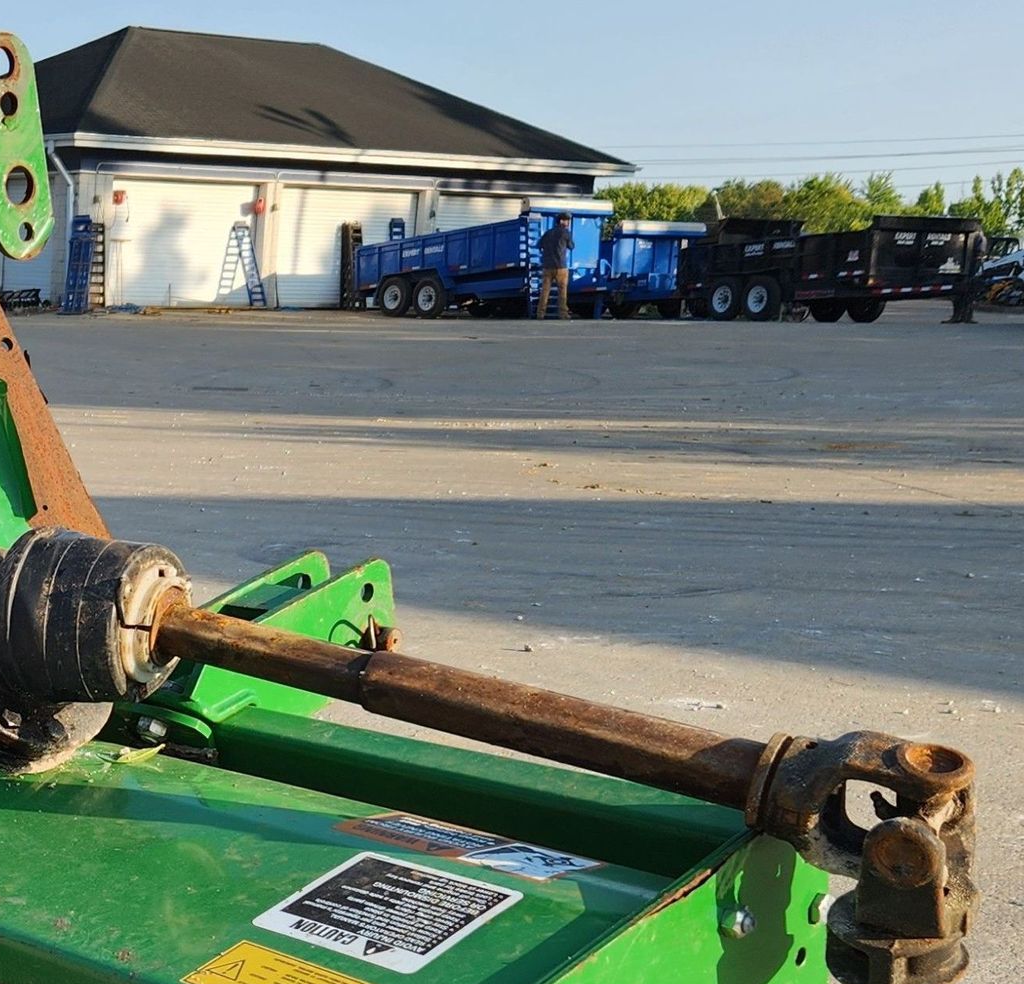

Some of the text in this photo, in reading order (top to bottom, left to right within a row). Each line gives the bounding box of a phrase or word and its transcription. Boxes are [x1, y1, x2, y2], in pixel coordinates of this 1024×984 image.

[287, 918, 359, 945] CAUTION
[355, 928, 427, 952] AVOID INJURY
